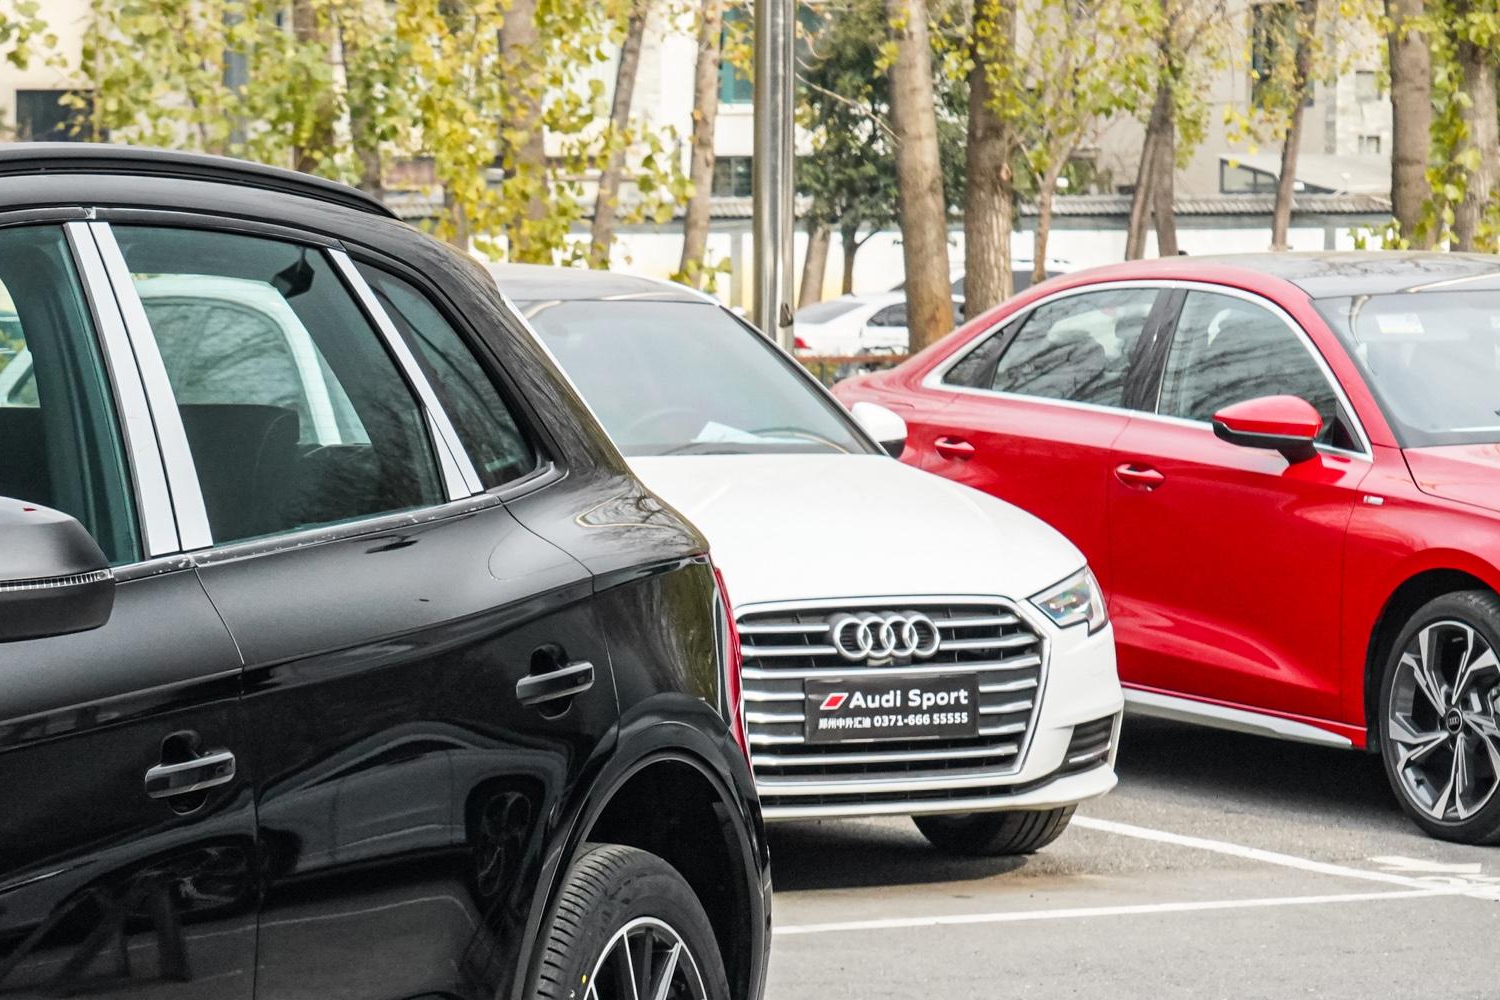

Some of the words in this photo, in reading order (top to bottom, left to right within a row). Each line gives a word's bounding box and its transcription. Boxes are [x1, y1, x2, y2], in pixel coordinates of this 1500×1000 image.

[849, 690, 901, 709] Audi
[907, 688, 969, 710] Sport
[933, 711, 968, 724] 55555
